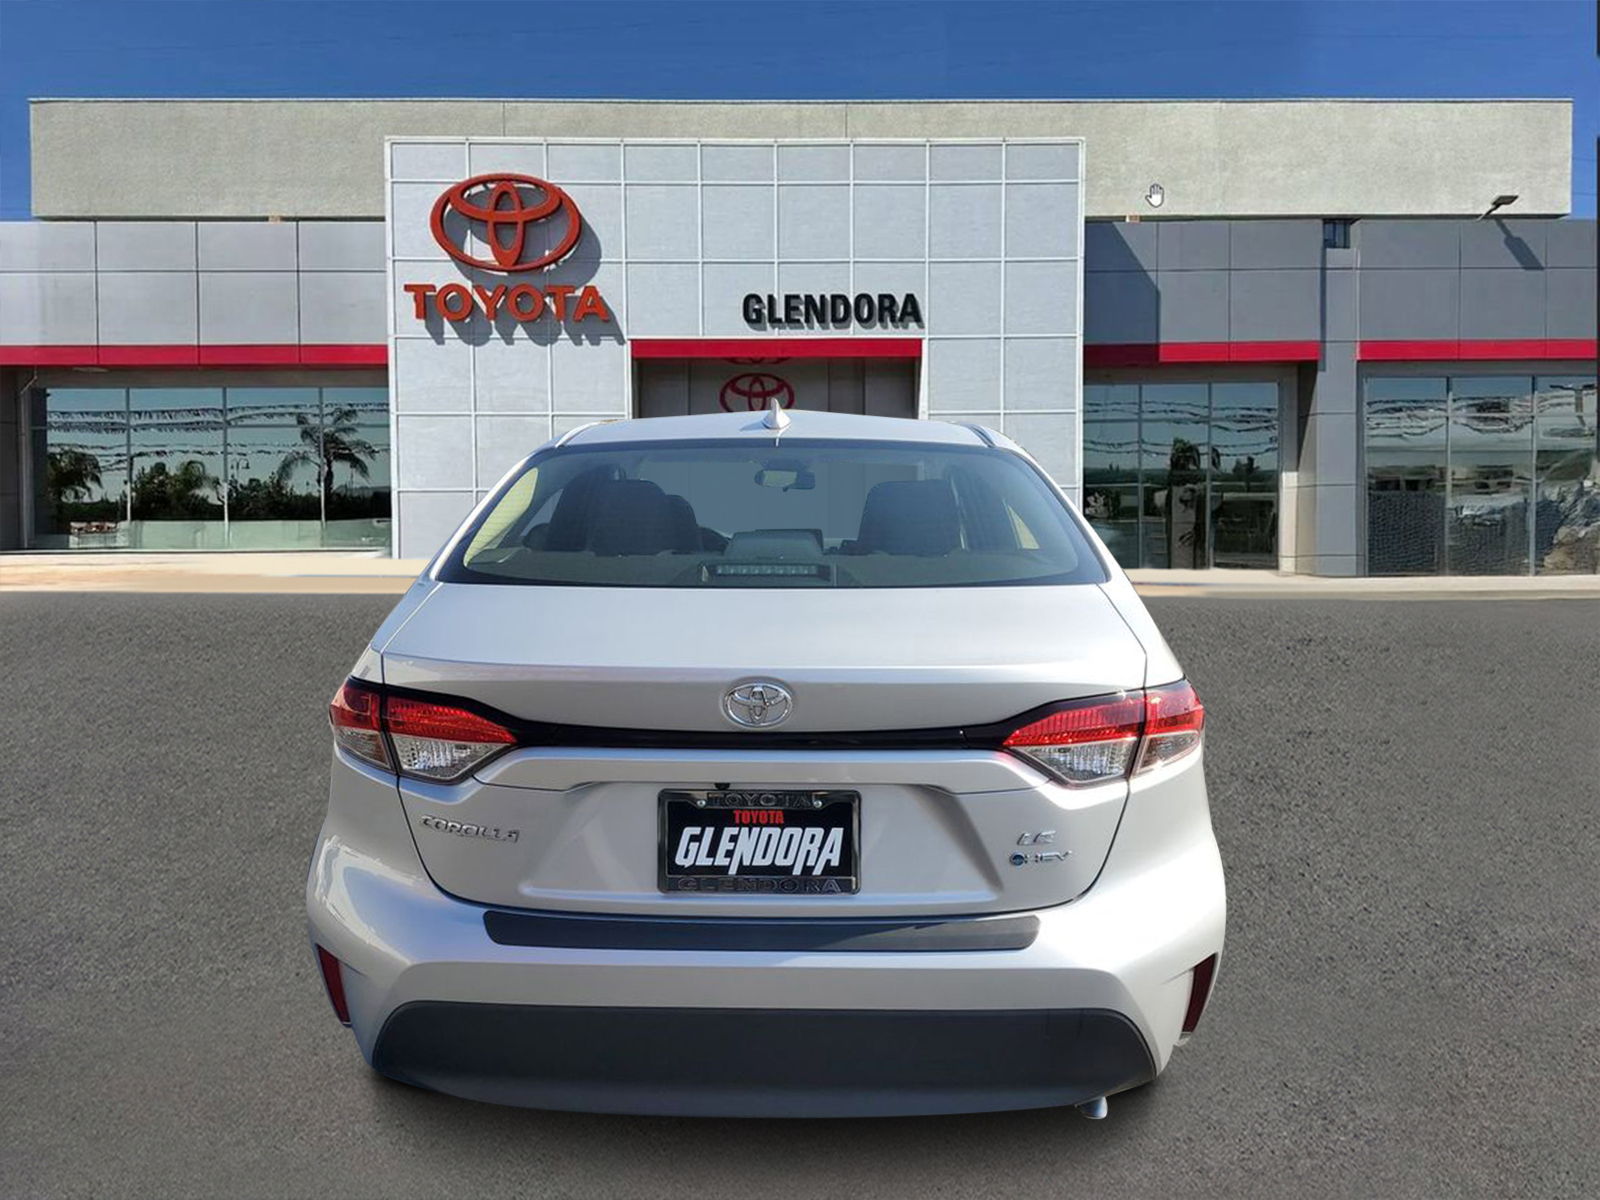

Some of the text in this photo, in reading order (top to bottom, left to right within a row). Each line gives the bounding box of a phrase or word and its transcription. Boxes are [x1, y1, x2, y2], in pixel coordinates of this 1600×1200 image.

[404, 283, 610, 323] TOYOTA
[743, 293, 922, 325] GLENDORA
[708, 793, 813, 807] TOYOTA
[421, 814, 520, 843] COROLLA
[733, 809, 785, 824] TOYOTA
[675, 826, 844, 875] GLENDORA
[677, 878, 842, 893] GLENDORA
